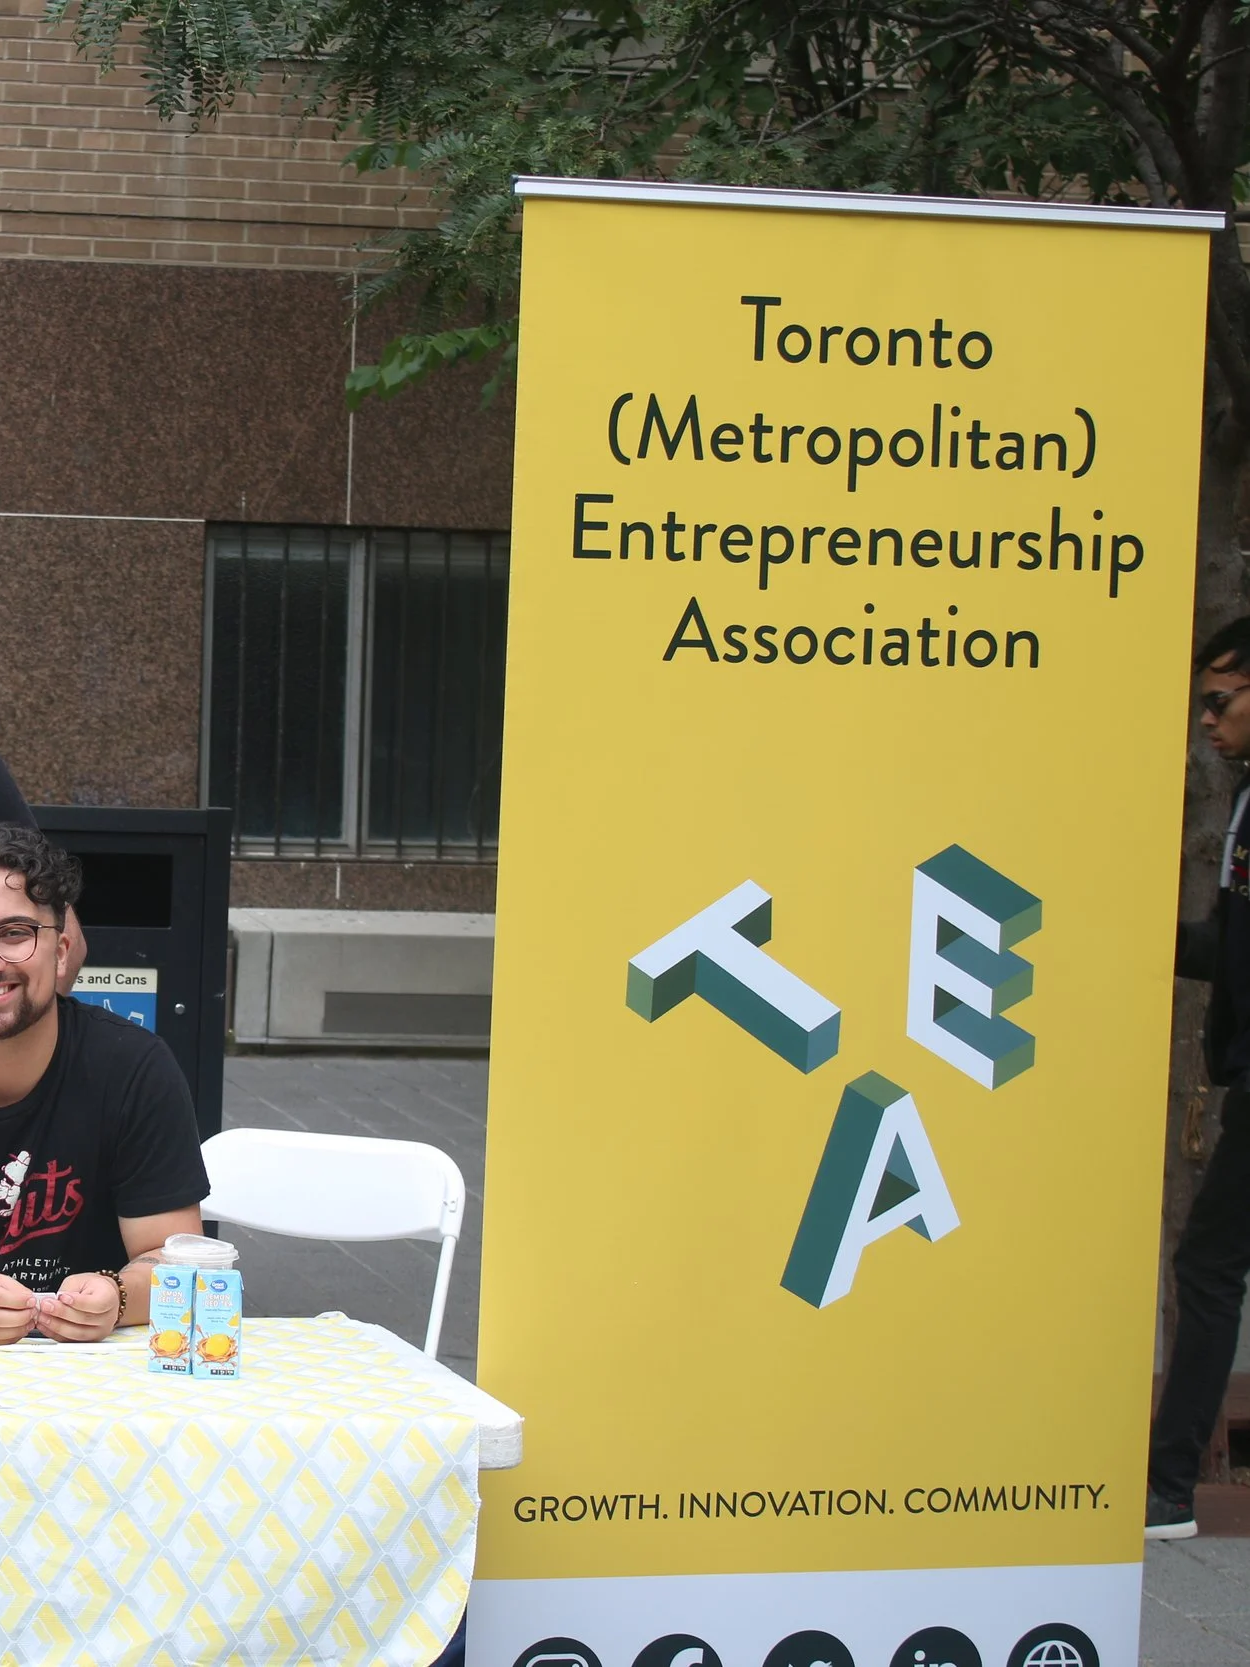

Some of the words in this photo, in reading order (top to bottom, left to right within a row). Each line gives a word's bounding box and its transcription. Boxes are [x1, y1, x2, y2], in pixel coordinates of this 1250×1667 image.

[741, 296, 993, 370] Toronto
[608, 393, 1096, 492] (Metropolitan)
[572, 493, 1144, 598] Entrepreneurship
[662, 597, 1040, 669] Association
[87, 974, 111, 985] and
[115, 974, 147, 985] Cans
[514, 1494, 668, 1523] GROWTH.
[679, 1489, 895, 1518] INNOVATION.
[904, 1484, 1110, 1513] COMMUNITY.
